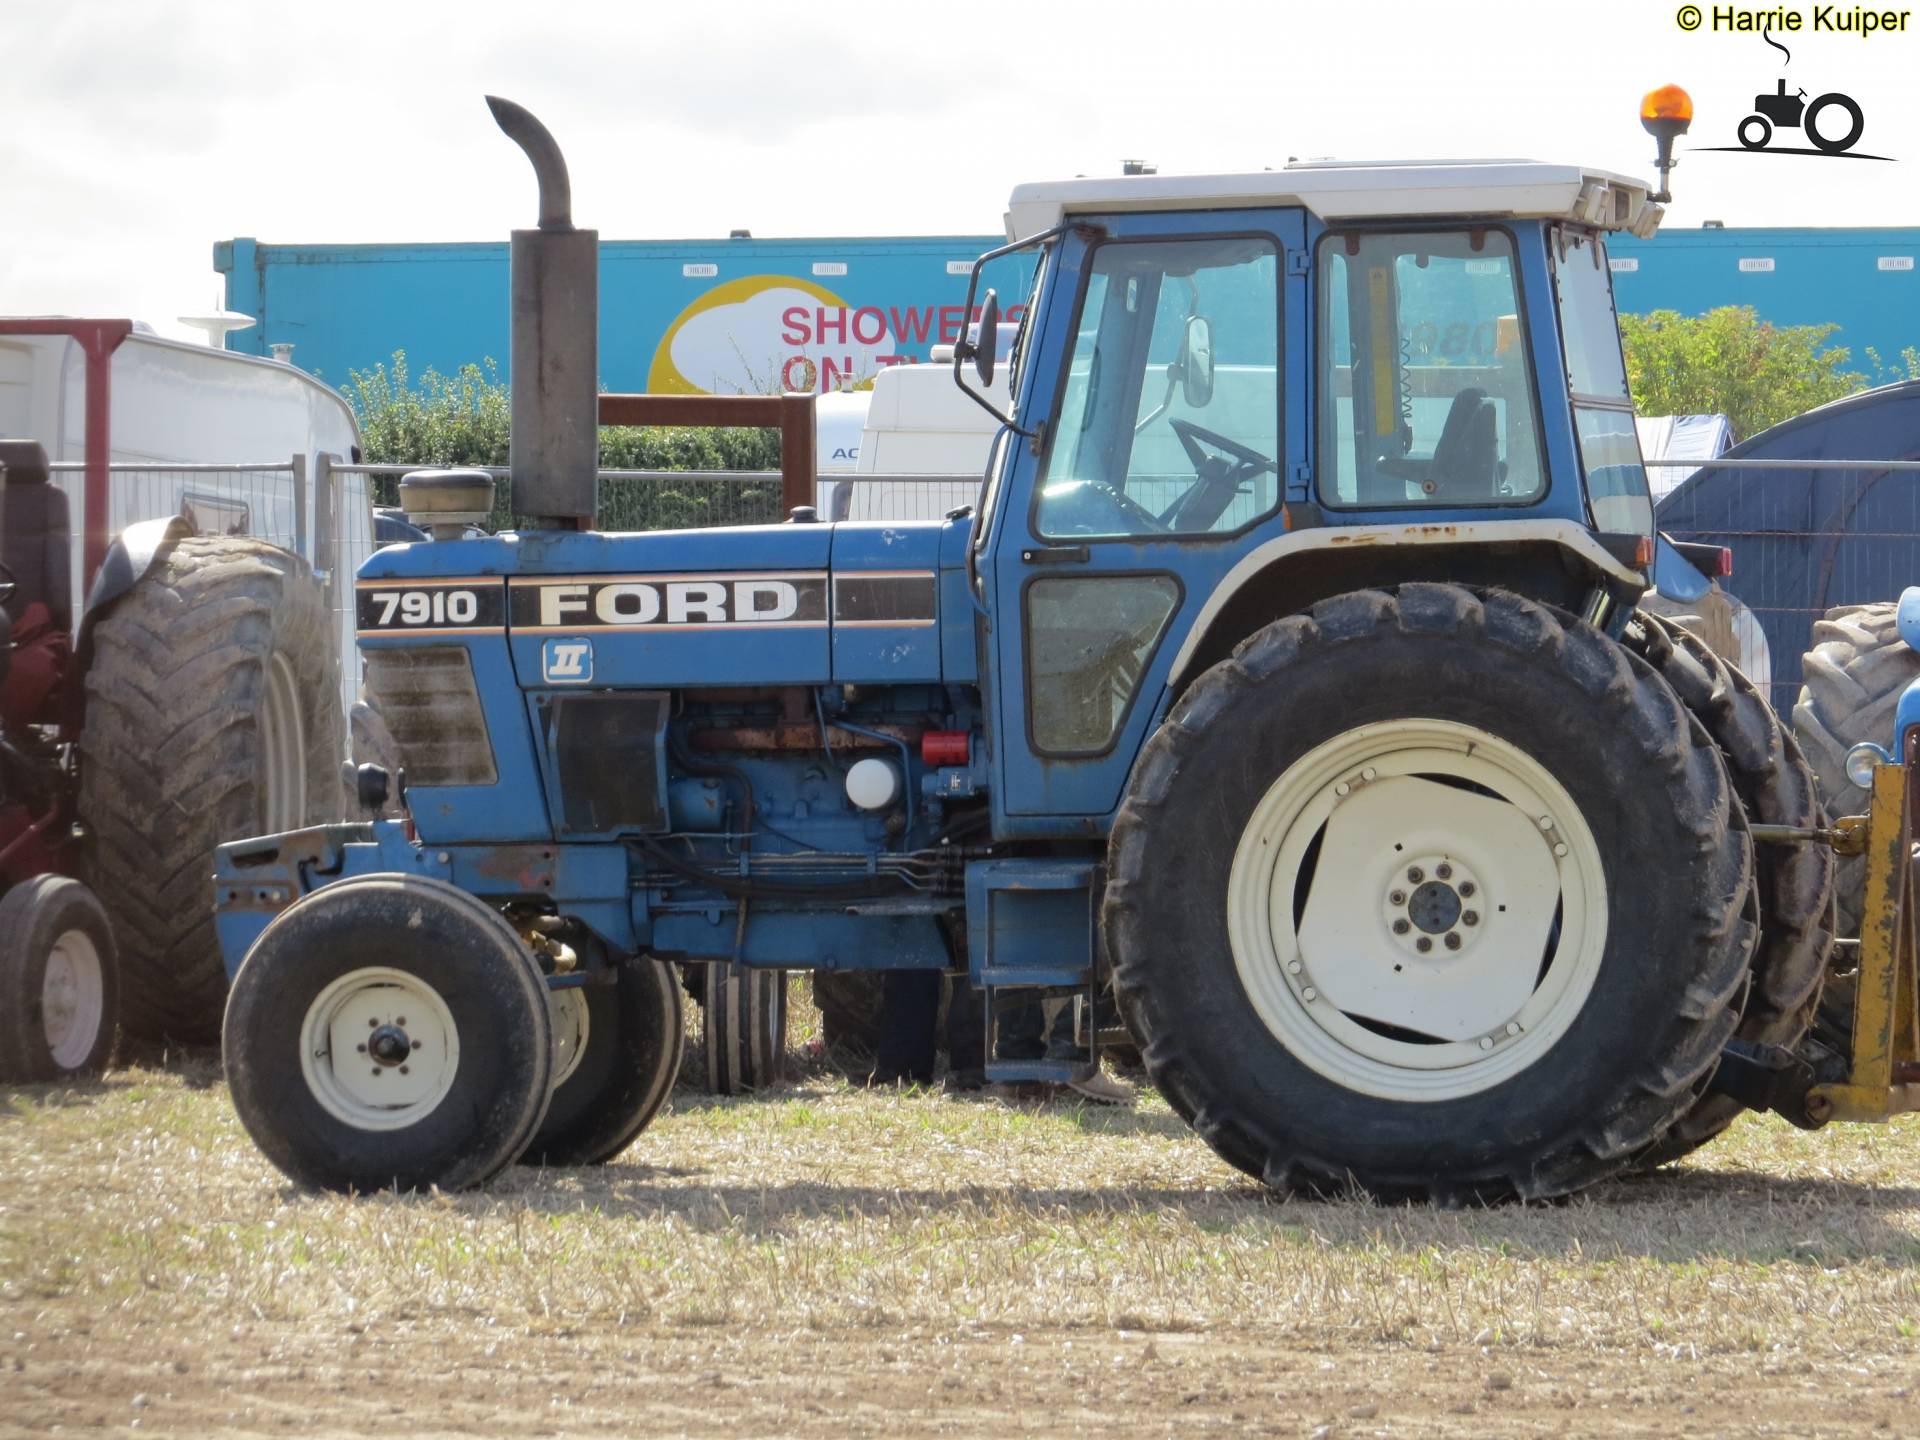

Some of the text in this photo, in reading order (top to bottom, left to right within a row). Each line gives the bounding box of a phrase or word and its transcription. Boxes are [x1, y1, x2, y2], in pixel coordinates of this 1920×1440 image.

[782, 304, 1026, 346] SHOWE
[782, 356, 852, 394] ON
[372, 590, 478, 625] 7910
[539, 581, 798, 626] FORD
[549, 644, 588, 676] II
